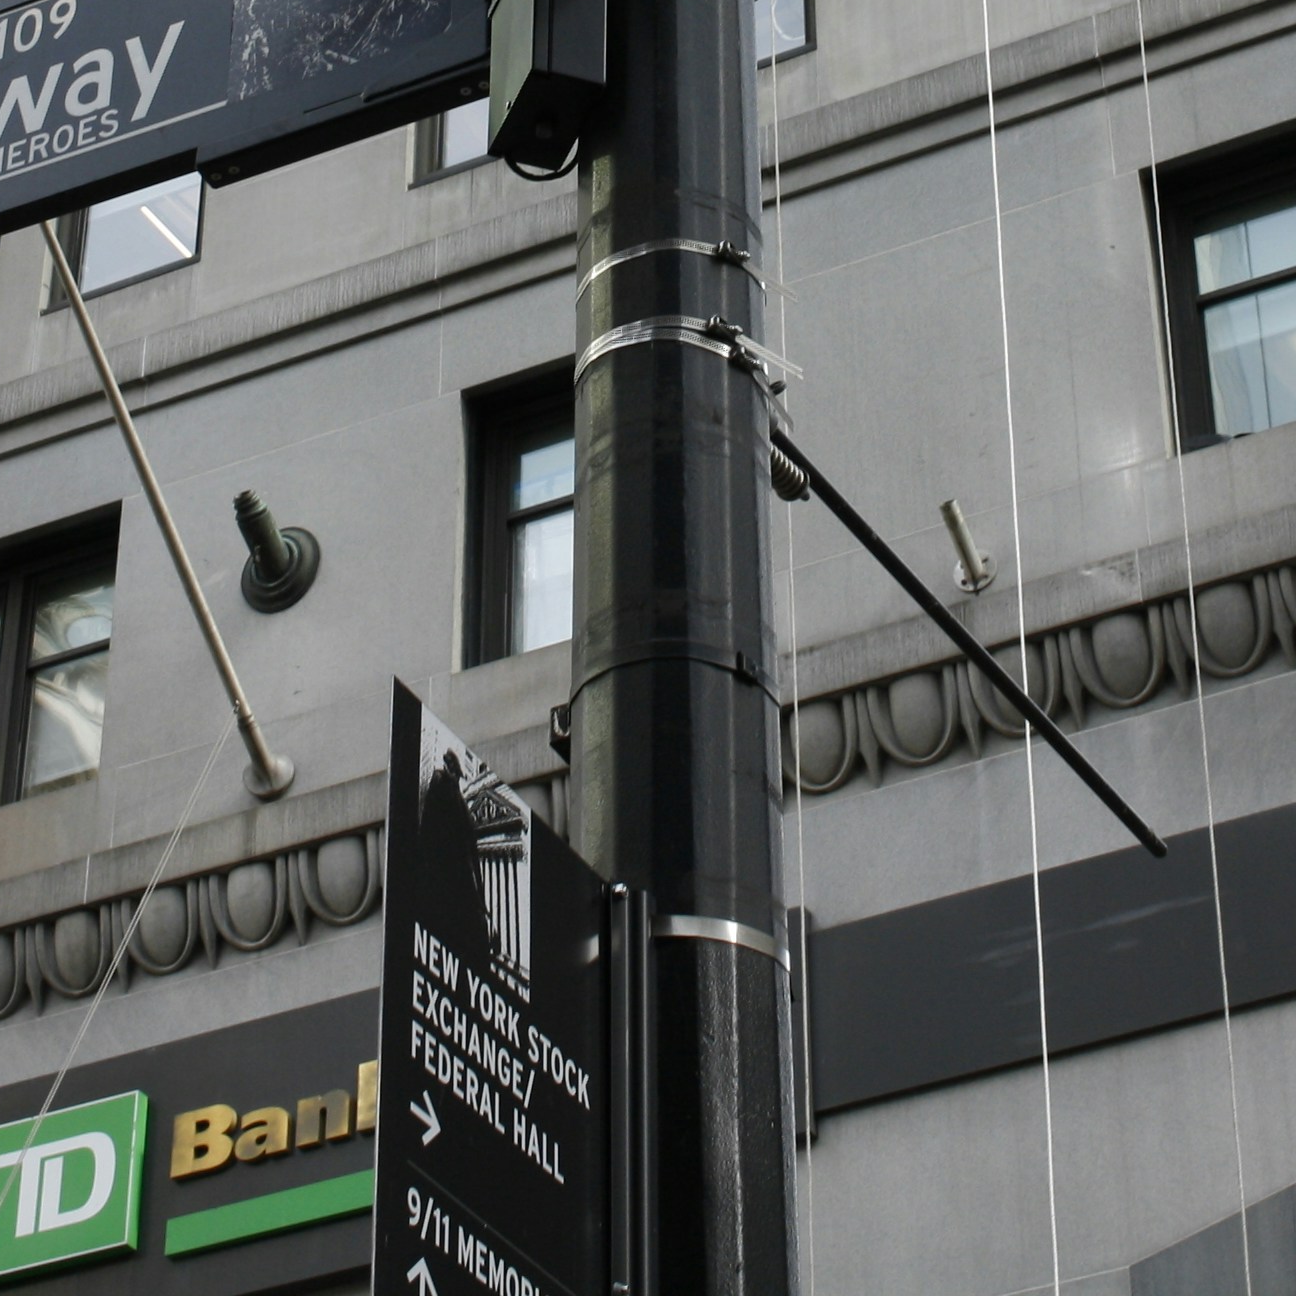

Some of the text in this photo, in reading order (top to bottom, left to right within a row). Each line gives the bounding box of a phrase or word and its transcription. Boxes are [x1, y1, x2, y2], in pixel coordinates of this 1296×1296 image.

[412, 970, 535, 1109] EXCHANGE/
[413, 921, 590, 1111] NEW YORK STOCK
[411, 1020, 565, 1185] FEDERAL HALL
[407, 1186, 548, 1296] 9/11 MEMO
